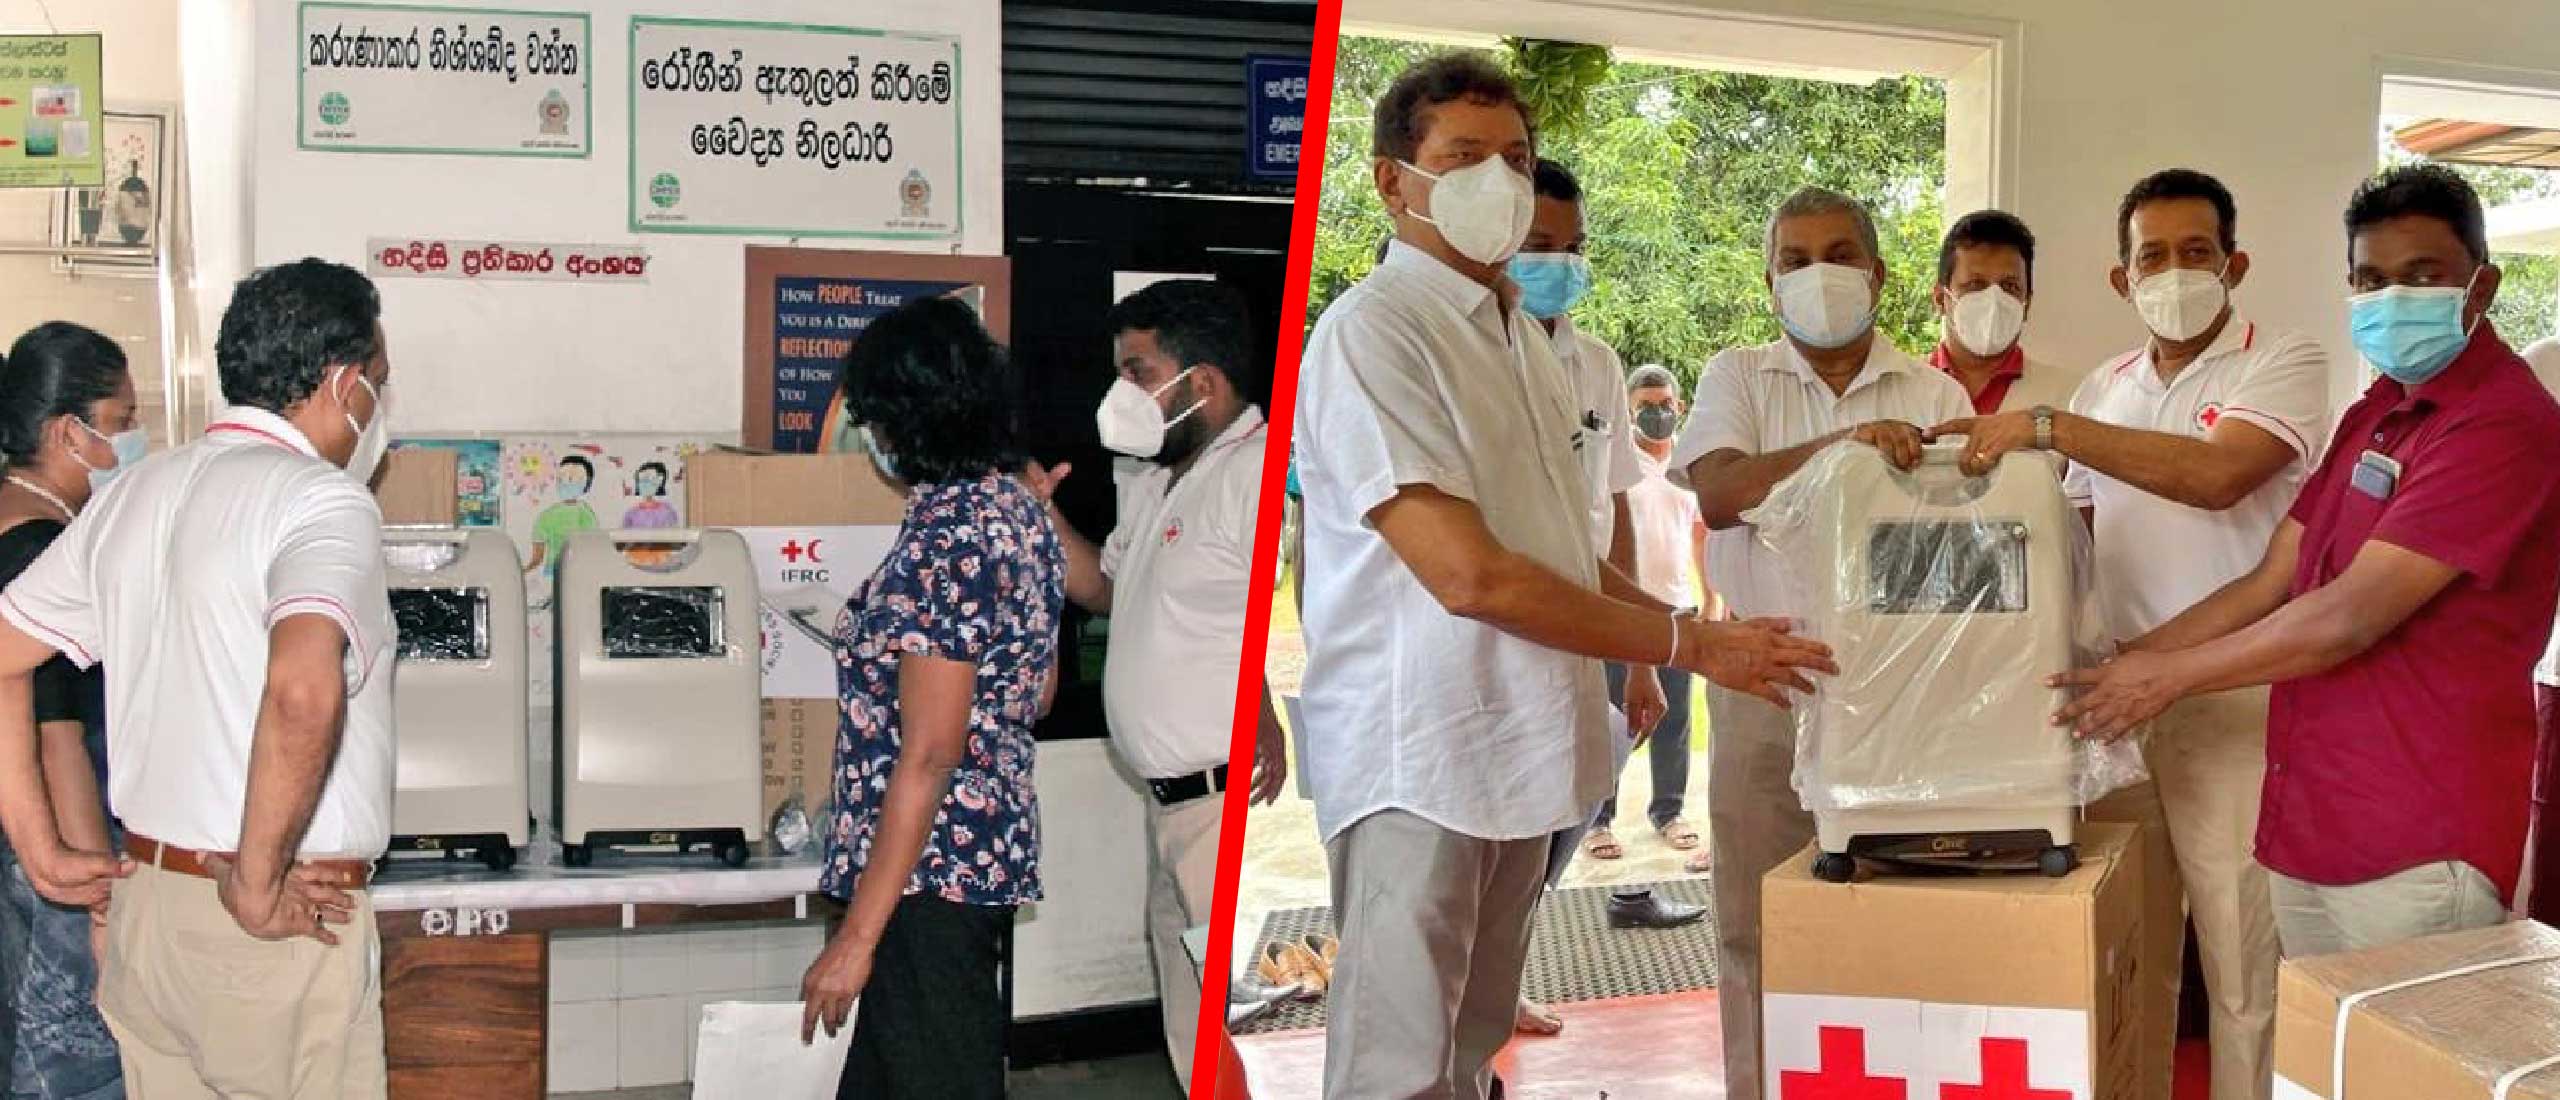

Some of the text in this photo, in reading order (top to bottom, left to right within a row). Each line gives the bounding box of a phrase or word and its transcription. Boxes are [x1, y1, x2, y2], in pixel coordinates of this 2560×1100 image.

[309, 22, 421, 69] කරුණාකර
[526, 28, 578, 75] වන්න
[643, 45, 743, 92] රෝගීන්
[755, 55, 860, 106] ඇතුලත්
[818, 284, 863, 305] PEOPLE
[823, 315, 833, 329] A
[779, 409, 813, 431] LOOK
[781, 568, 830, 583] IFRC
